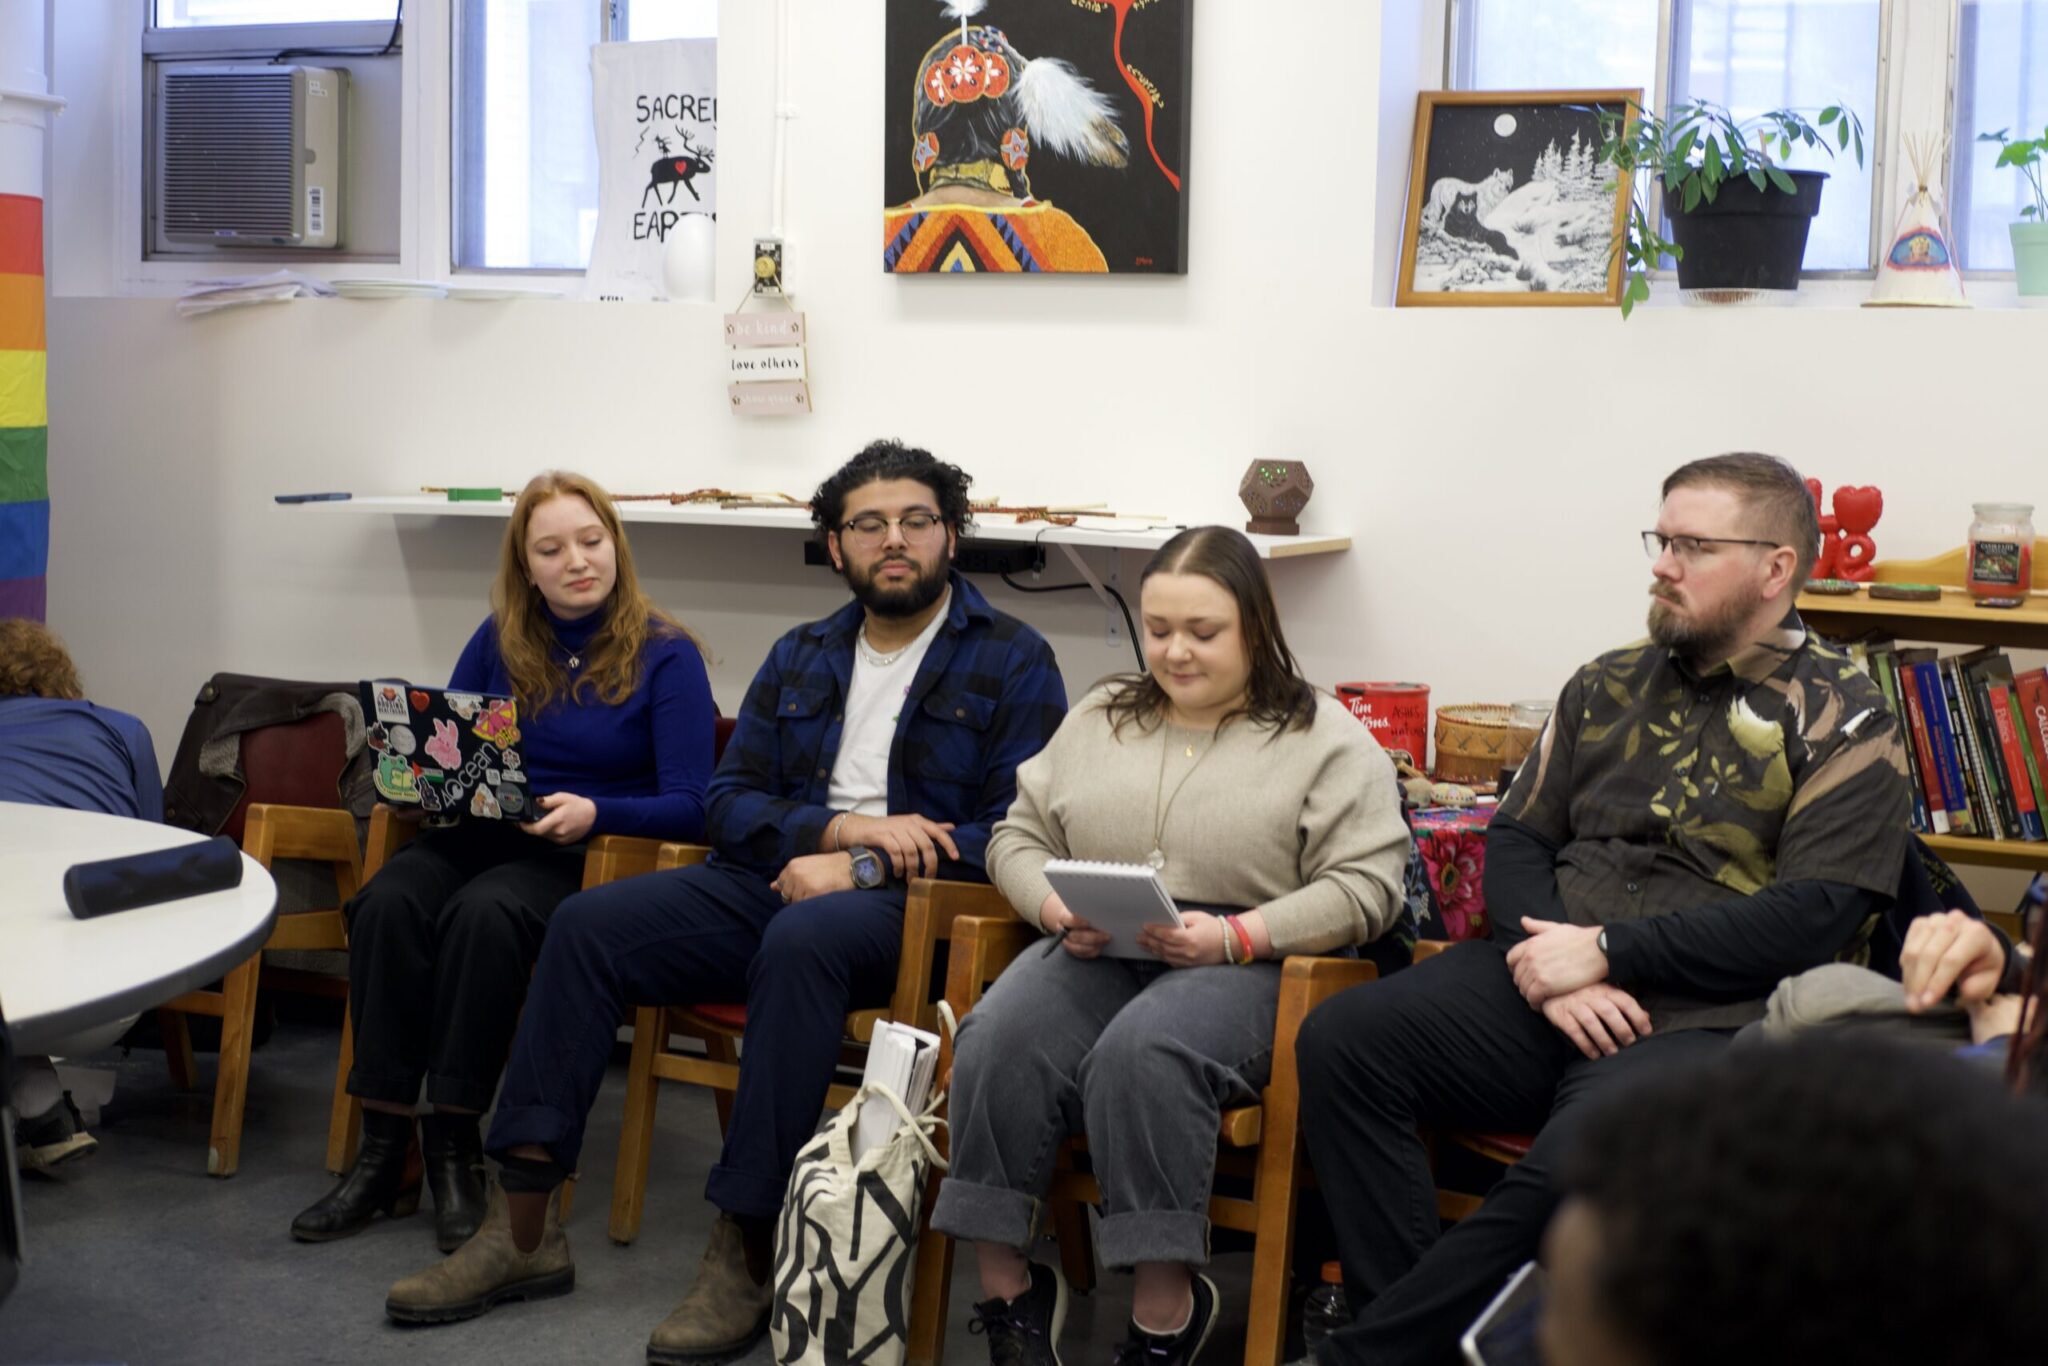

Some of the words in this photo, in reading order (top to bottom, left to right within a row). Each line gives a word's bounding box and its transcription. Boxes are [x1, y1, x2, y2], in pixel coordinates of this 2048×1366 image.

[756, 319, 788, 336] kind
[731, 359, 755, 371] love
[761, 357, 800, 370] others
[1348, 696, 1372, 714] Tim
[1361, 715, 1390, 730] tons
